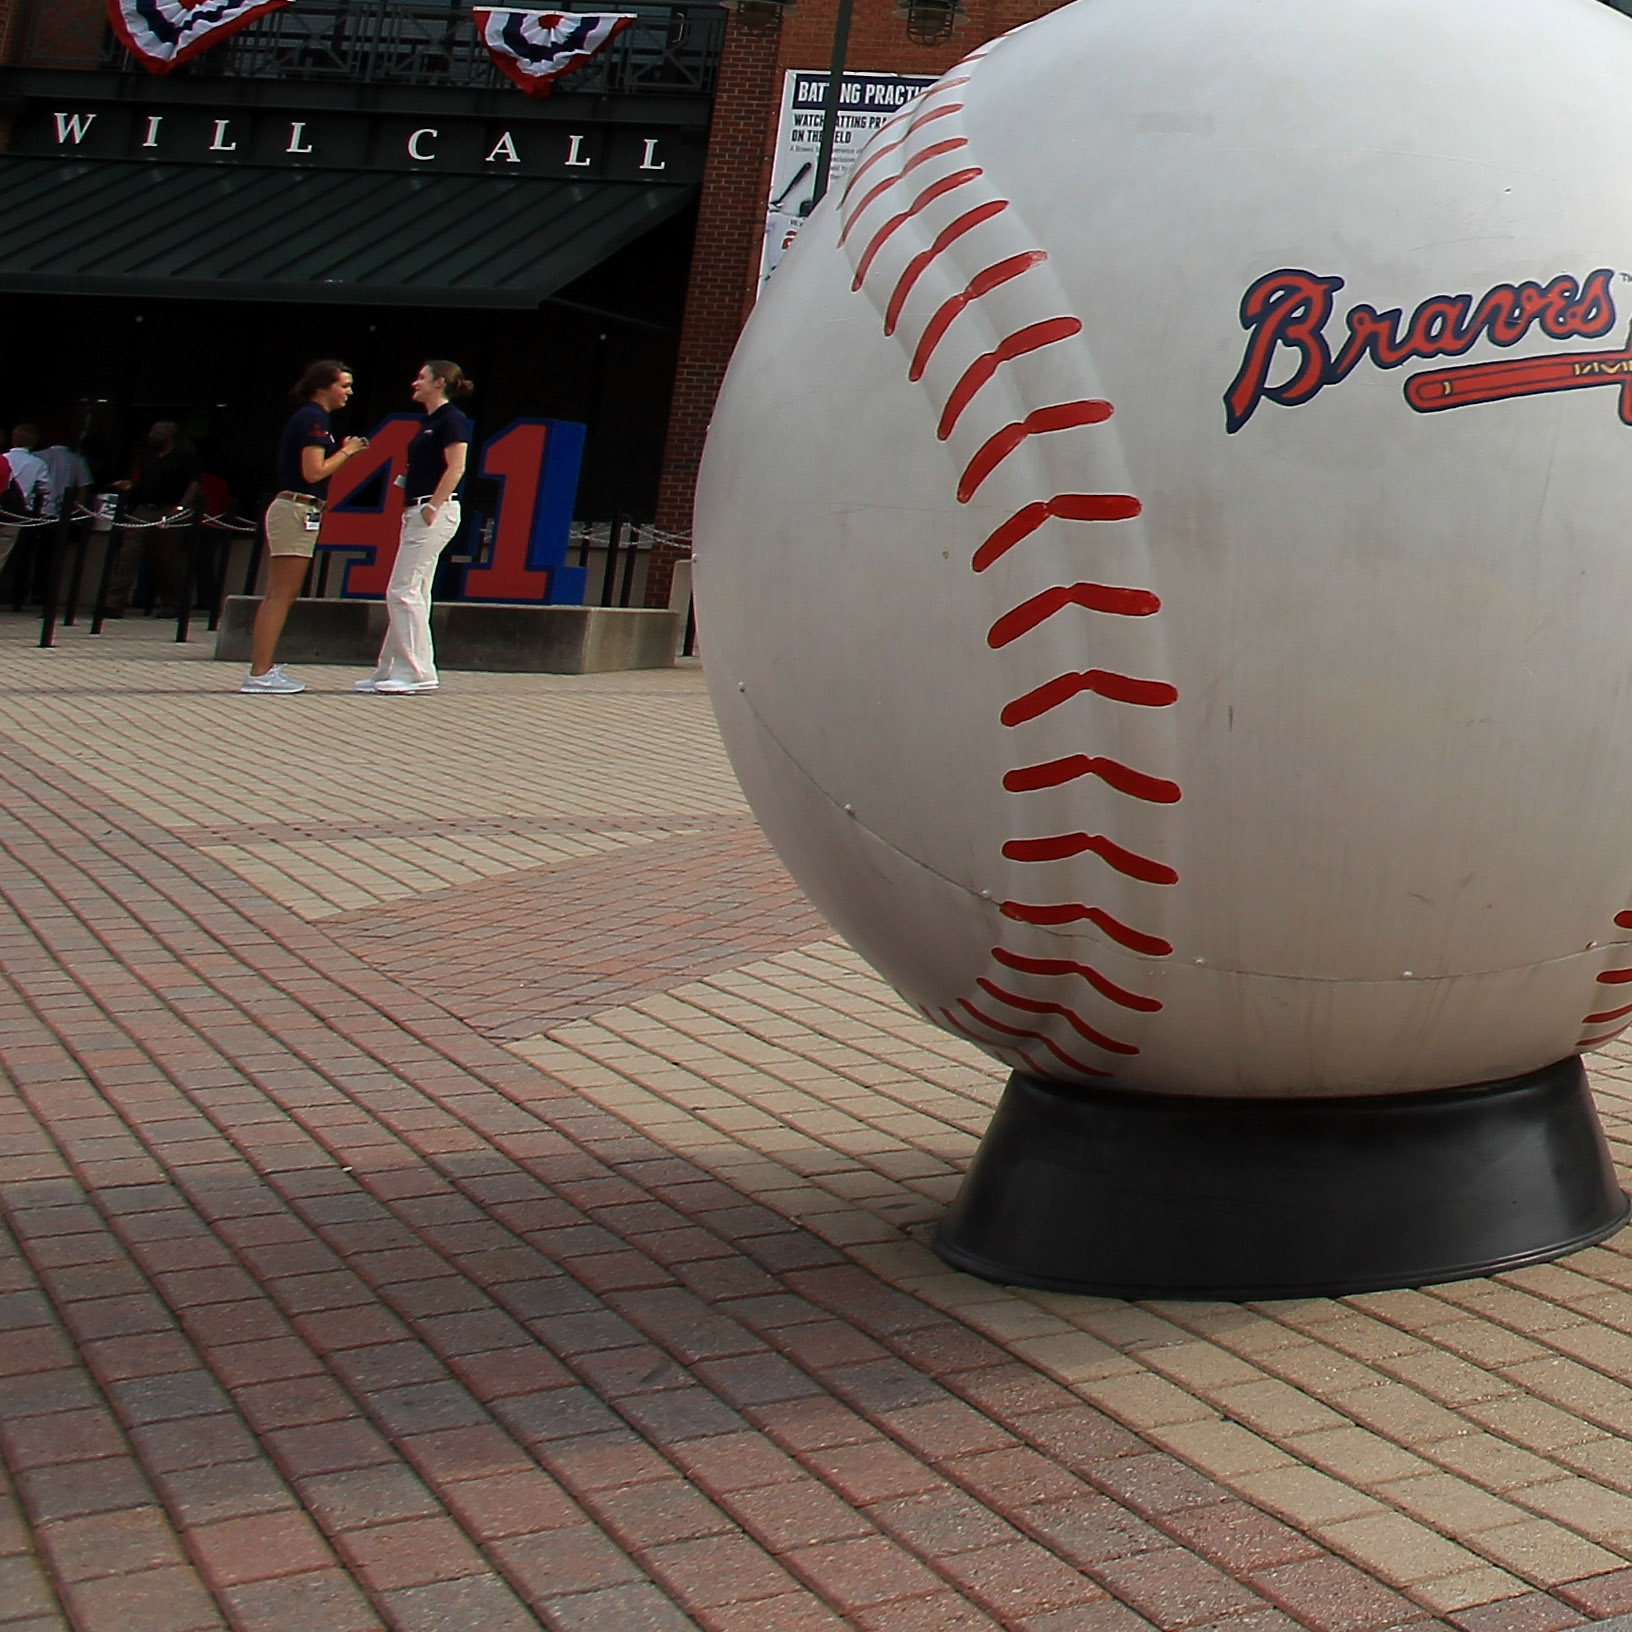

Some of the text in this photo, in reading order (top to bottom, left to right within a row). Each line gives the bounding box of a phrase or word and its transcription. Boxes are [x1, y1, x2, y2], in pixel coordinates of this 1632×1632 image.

[798, 81, 861, 104] BATNG
[52, 111, 666, 171] WILL CALL
[791, 129, 804, 143] ON
[834, 131, 851, 144] ELD
[1223, 268, 1616, 435] Braves
[318, 412, 556, 605] 41
